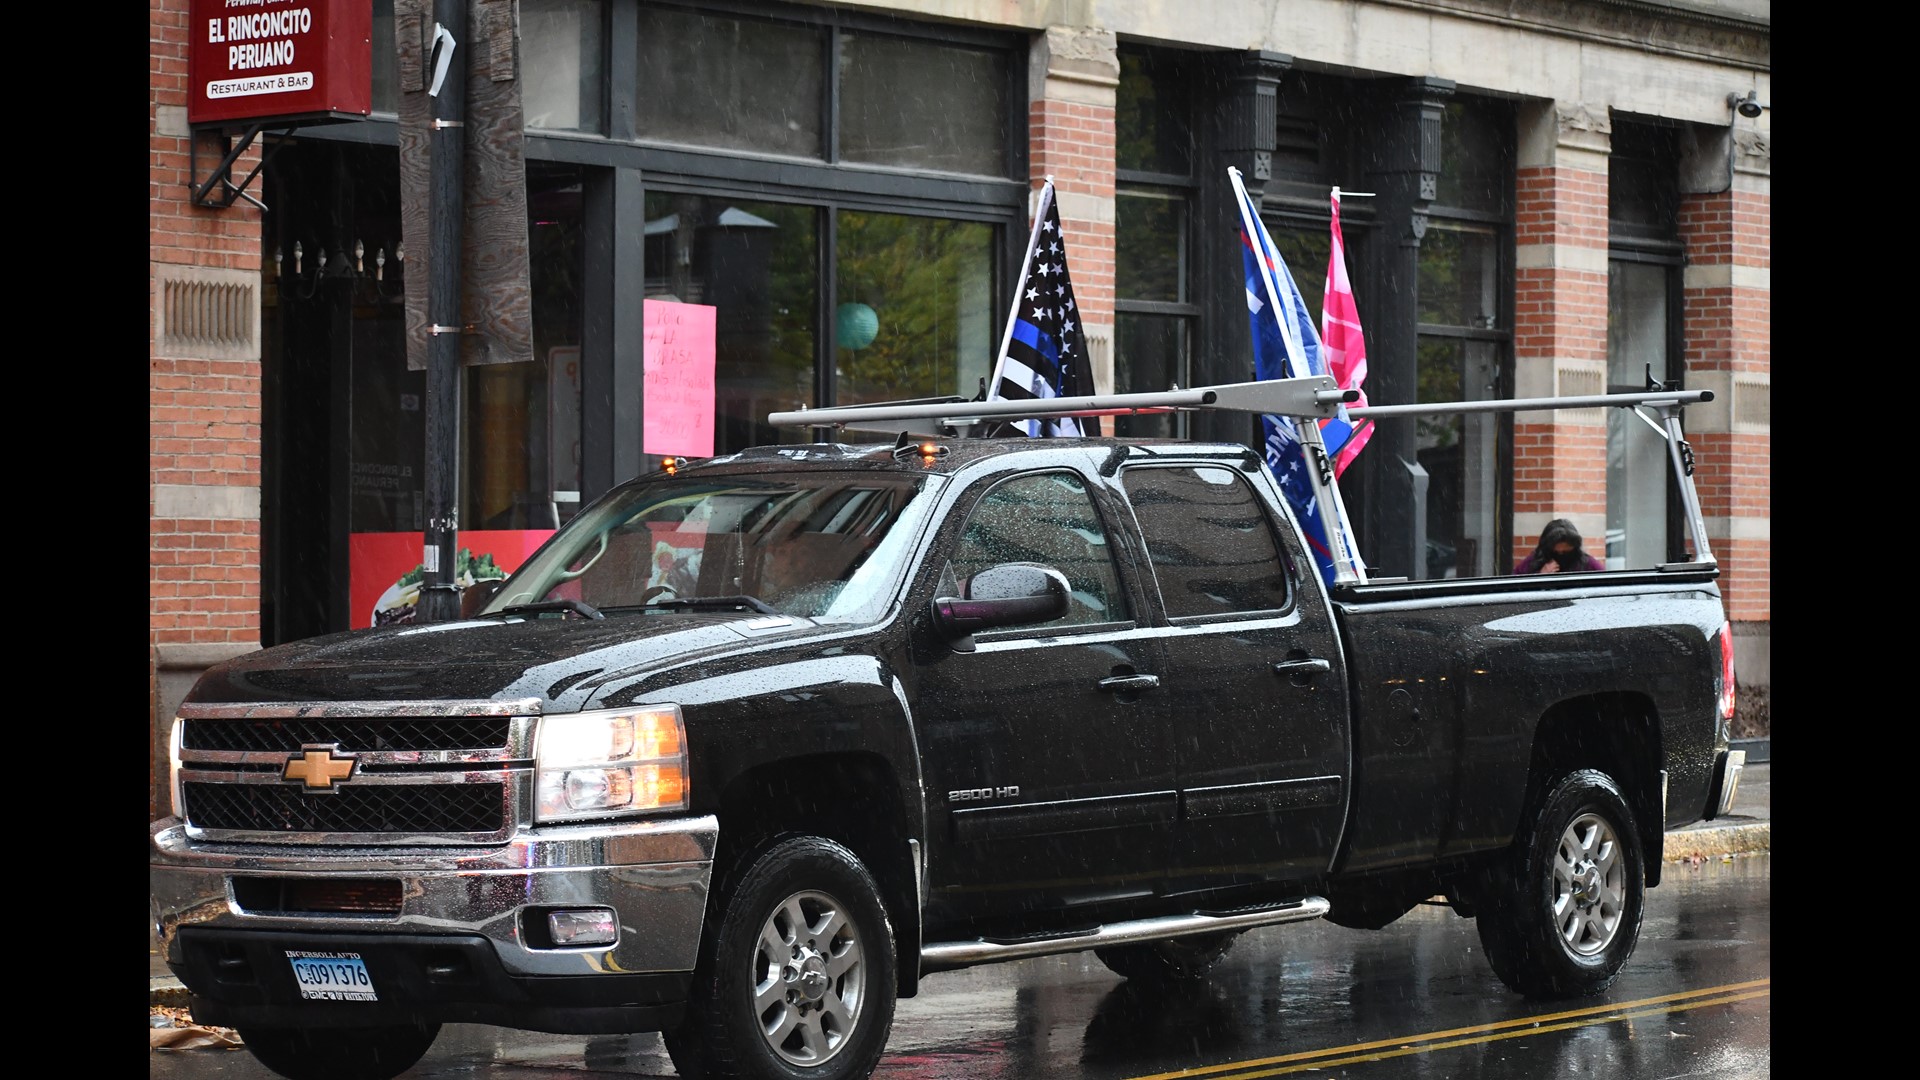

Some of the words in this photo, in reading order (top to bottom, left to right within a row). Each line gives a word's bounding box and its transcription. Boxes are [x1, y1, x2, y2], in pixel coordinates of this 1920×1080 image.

[208, 18, 226, 43] EL
[228, 7, 311, 41] RINCONCITO
[229, 39, 295, 70] PERUANO
[277, 78, 285, 88] &
[948, 787, 993, 801] 2500
[996, 785, 1020, 798] HD
